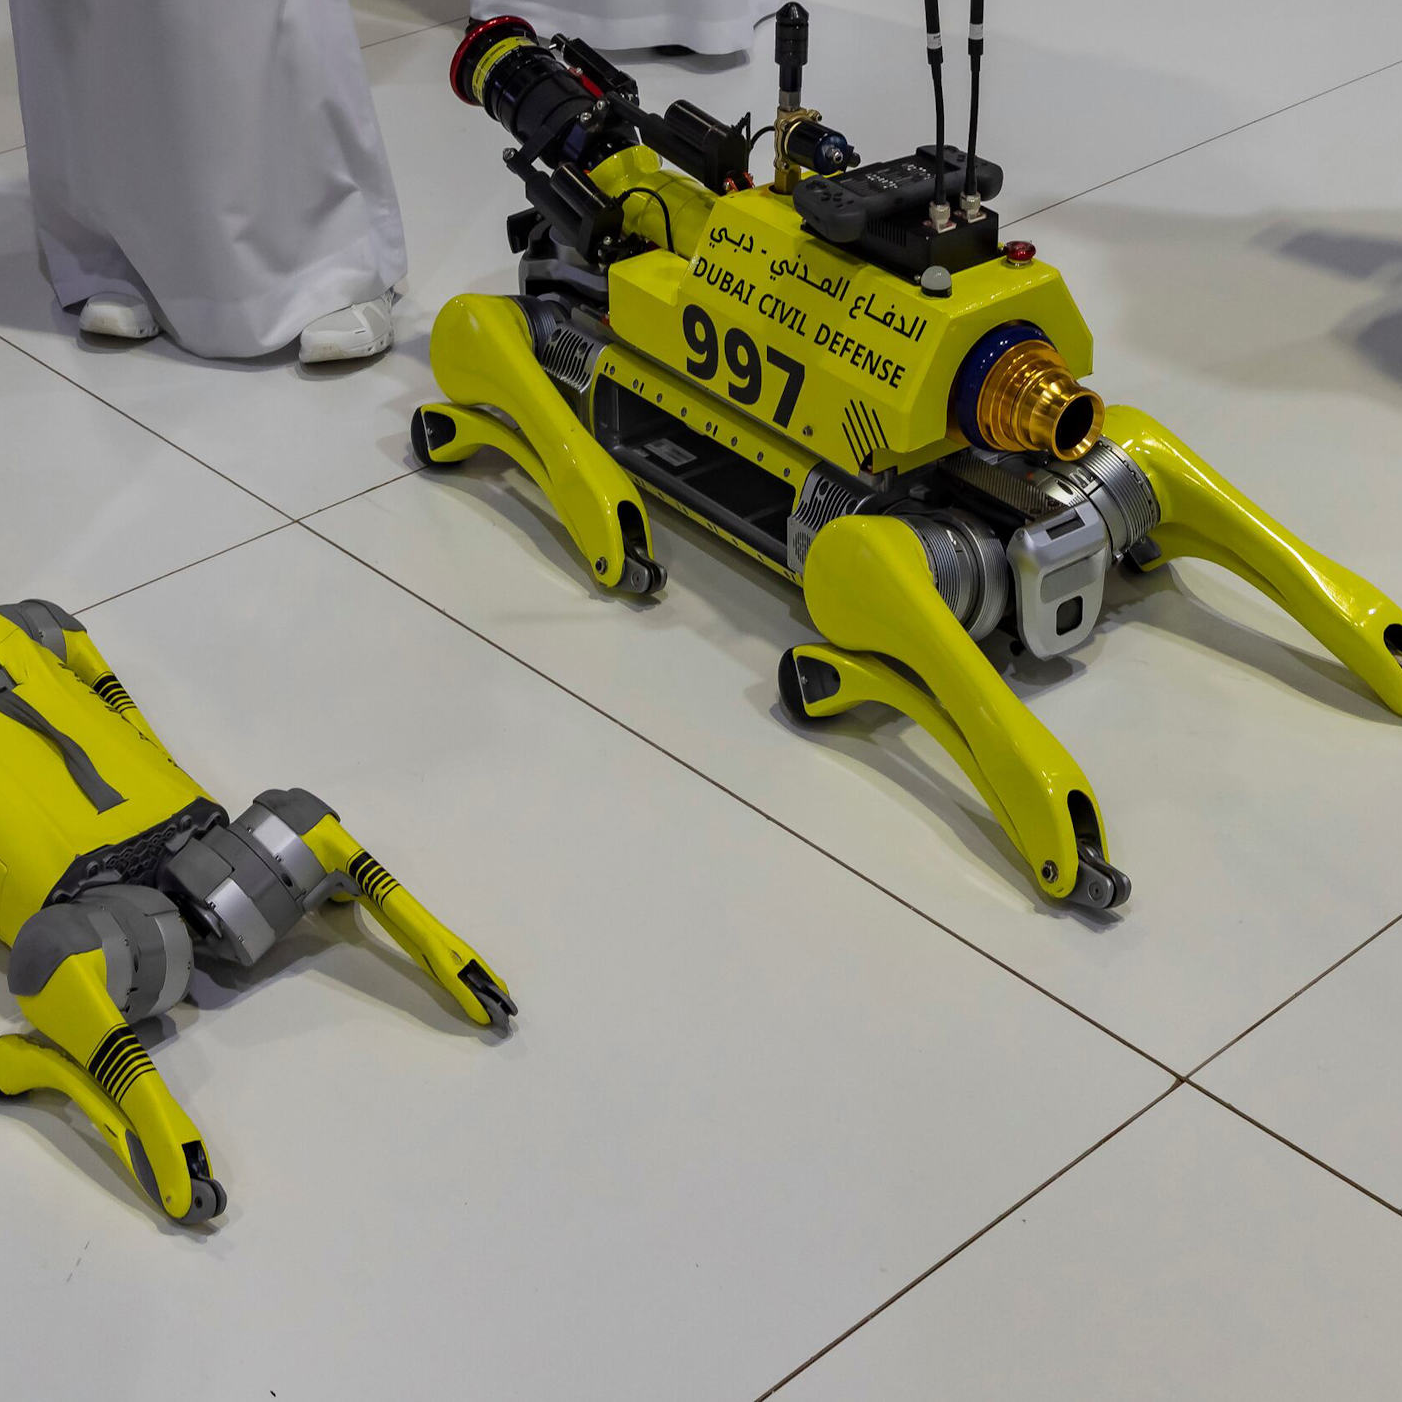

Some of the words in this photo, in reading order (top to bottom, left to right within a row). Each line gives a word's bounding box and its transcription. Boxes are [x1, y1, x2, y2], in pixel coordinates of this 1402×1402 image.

[709, 225, 755, 254] دبي
[693, 256, 756, 306] DUBAI
[757, 292, 807, 337] CIVIL
[813, 322, 906, 390] DEFENSE
[848, 293, 928, 342] الدفاع
[682, 303, 806, 430] 997
